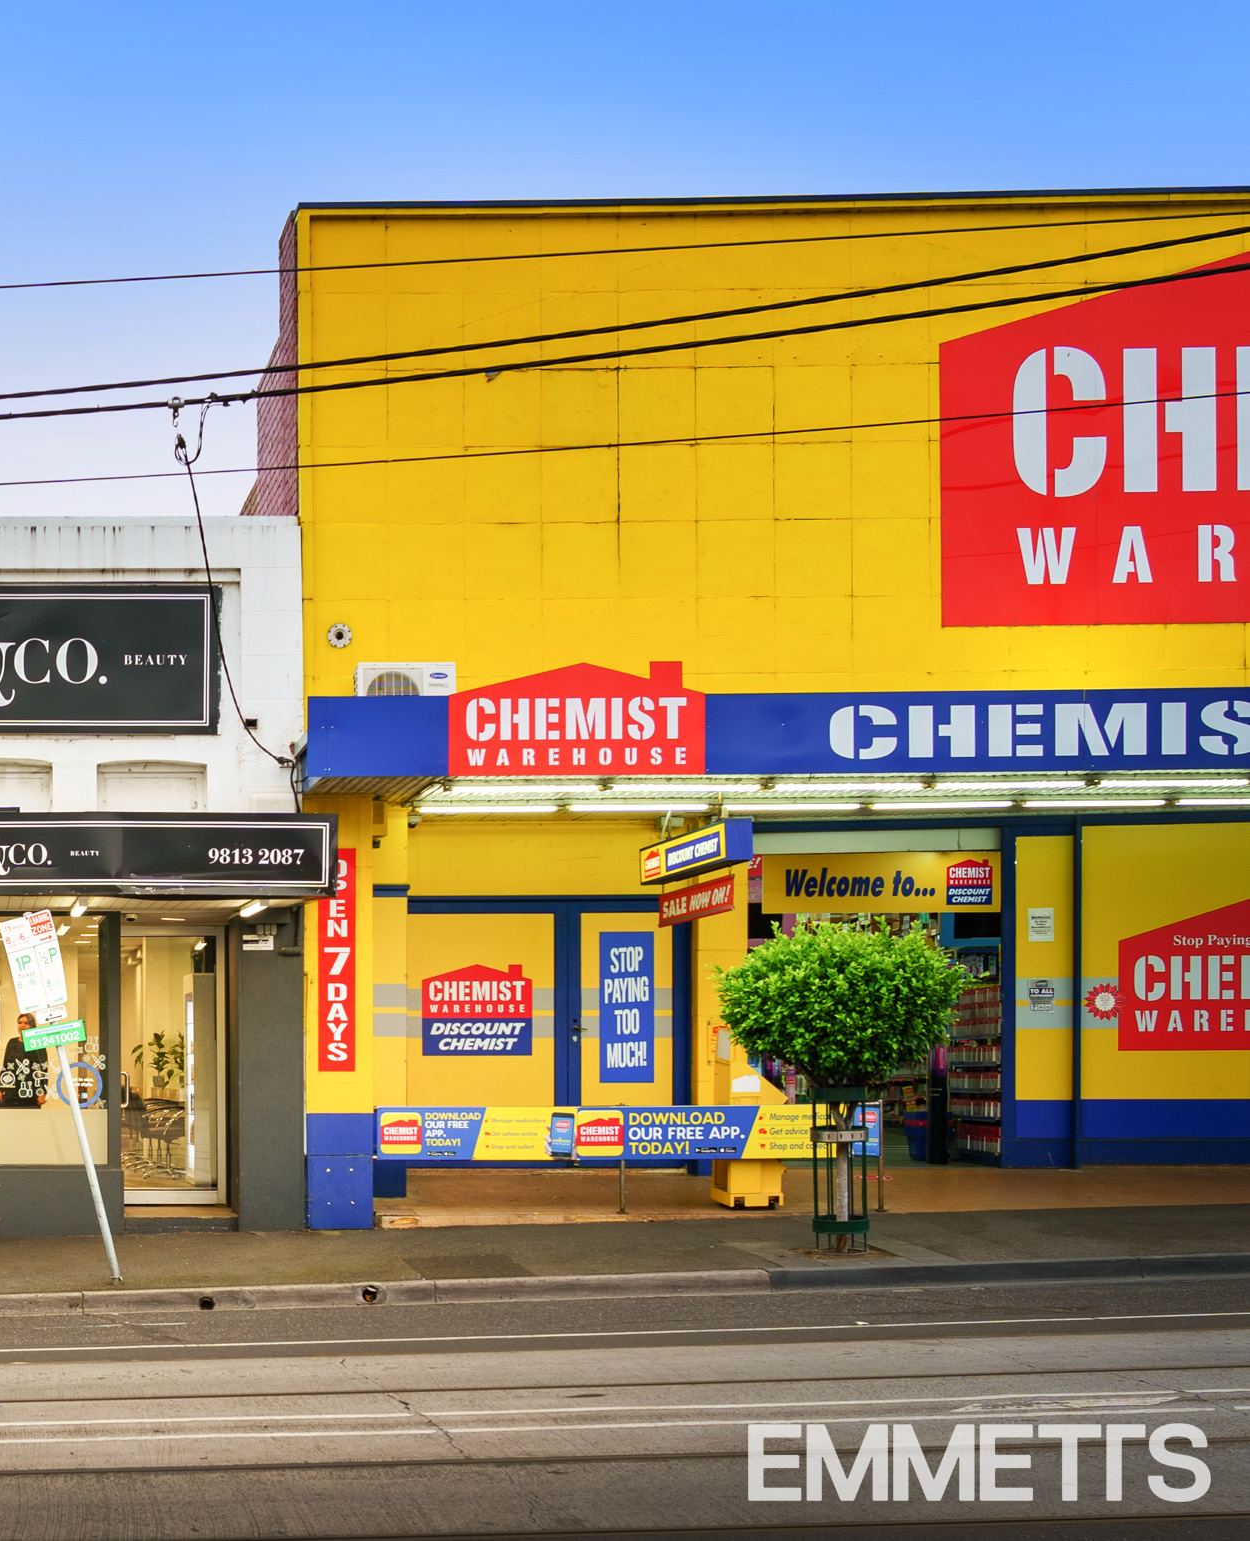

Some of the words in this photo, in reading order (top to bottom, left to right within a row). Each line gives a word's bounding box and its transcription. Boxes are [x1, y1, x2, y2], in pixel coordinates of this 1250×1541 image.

[1013, 345, 1250, 498] CH
[124, 654, 188, 666] BEAUTY
[466, 696, 687, 742] CHEMIST
[829, 700, 1250, 760] CHEMIS
[467, 747, 687, 767] WAREHOUSE
[208, 848, 253, 865] 9813
[258, 848, 304, 865] 2087
[667, 845, 694, 866] DISCOUNT
[694, 837, 719, 858] CHEMIST
[949, 866, 990, 879] CHEMIST
[785, 867, 884, 898] Welcome
[892, 870, 936, 897] to...
[662, 896, 687, 919] SALE
[689, 890, 711, 912] NOW
[712, 884, 731, 906] ON!
[32, 924, 52, 935] ZONE
[1173, 934, 1204, 948] Stop
[1207, 934, 1250, 948] Paying
[16, 955, 32, 971] 1P
[324, 947, 350, 976] 7
[610, 946, 644, 973] STOP
[429, 980, 525, 1002] CHEMIST
[604, 976, 649, 1004] PAYING
[429, 1004, 525, 1013] WAREHOUSE
[326, 983, 348, 1062] DAYS
[430, 1022, 526, 1035] DISCOUNT
[614, 1008, 640, 1035] TOO
[30, 1031, 80, 1048] 31241002
[438, 1038, 518, 1050] CHEMIST
[606, 1041, 647, 1068] MUCH!
[424, 1112, 481, 1121] DOWNLOAD
[629, 1112, 725, 1125] DOWNLOAD
[769, 1113, 799, 1122] Manage
[384, 1126, 418, 1135] CHEMIST
[425, 1121, 445, 1129] OUR
[448, 1121, 469, 1129] FREE
[580, 1126, 620, 1136] CHEMIST
[425, 1129, 446, 1137] APP.
[628, 1127, 662, 1140] OUR
[668, 1126, 704, 1140] FREE
[708, 1126, 746, 1139] APP.
[425, 1138, 461, 1146] TODAY!
[629, 1141, 690, 1155] TODAY!
[769, 1142, 788, 1151] Shop
